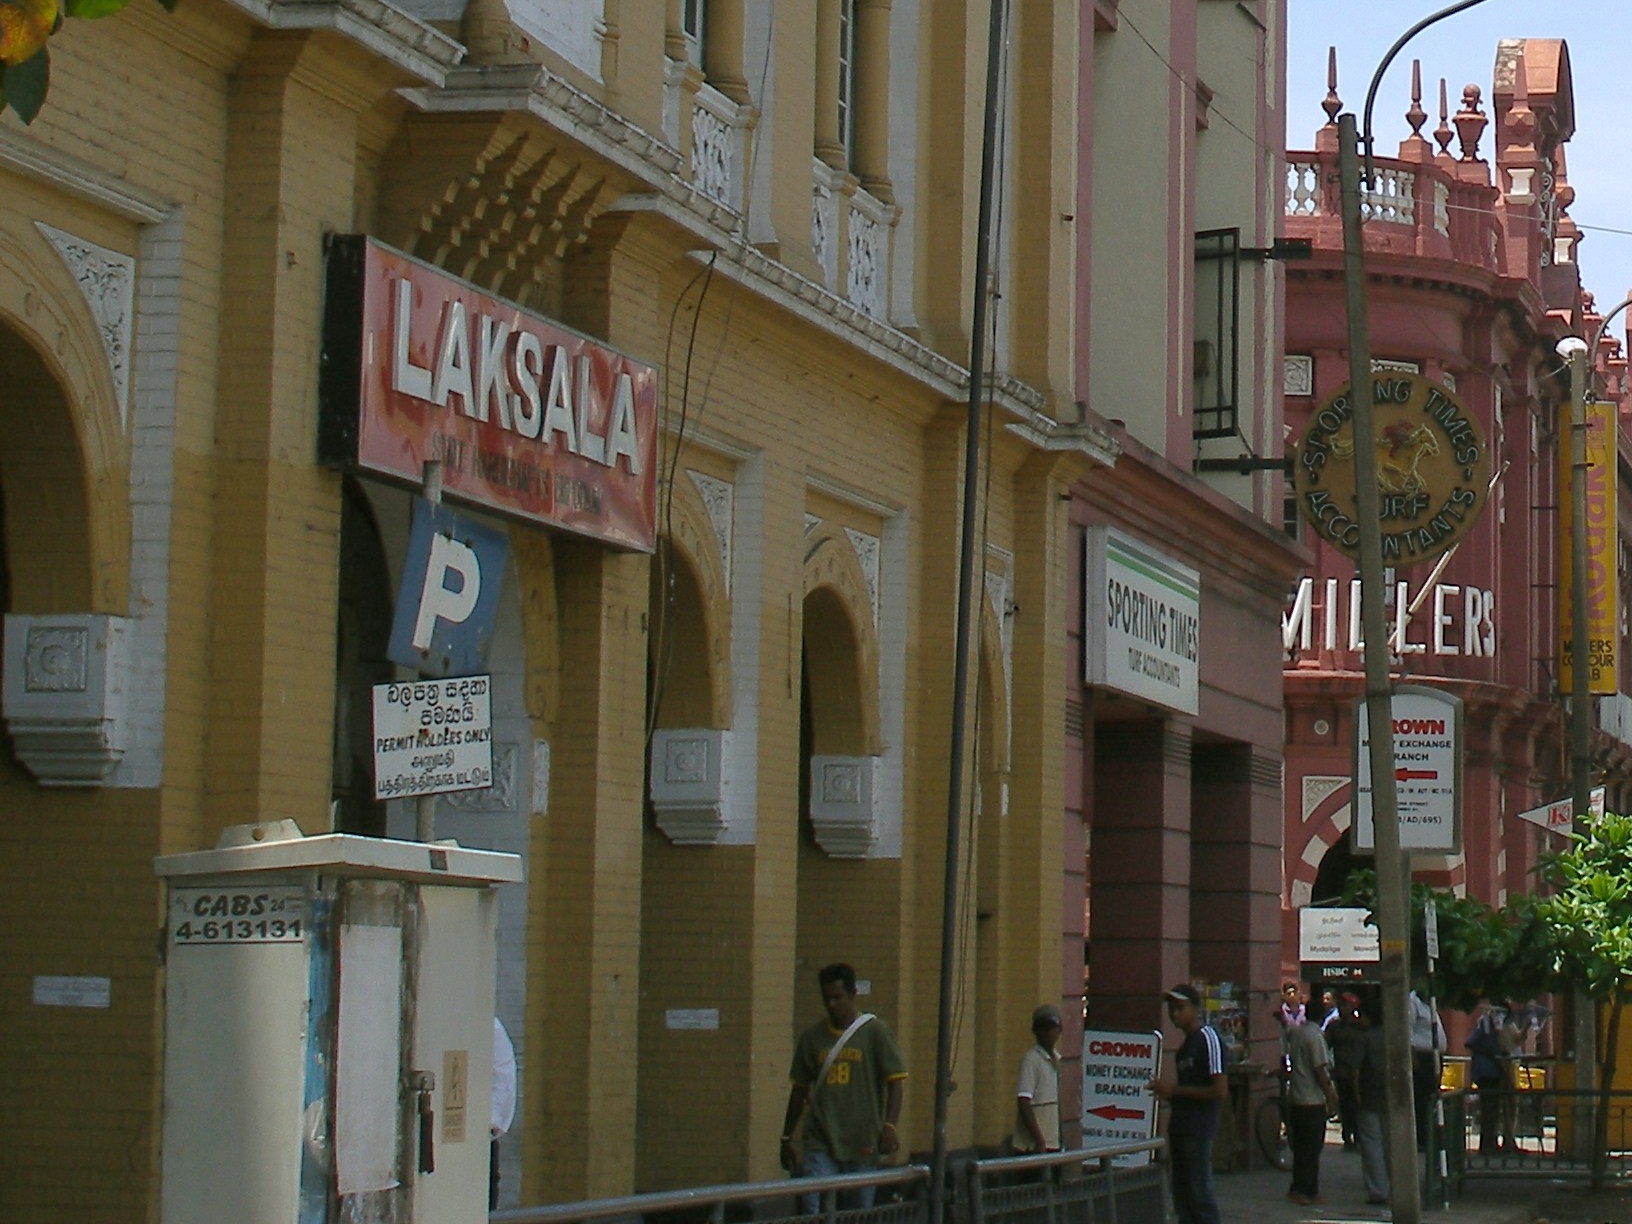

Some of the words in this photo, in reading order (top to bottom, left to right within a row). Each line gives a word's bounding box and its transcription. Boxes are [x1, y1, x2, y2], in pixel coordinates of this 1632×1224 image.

[392, 277, 640, 476] LAKSALA
[1303, 379, 1413, 467] SPORNG
[1423, 386, 1480, 466] TIMES
[1305, 487, 1477, 557] ACCONTANTS
[412, 532, 481, 651] P
[1107, 578, 1167, 649] SPORTING
[1169, 607, 1198, 663] TIMES
[1563, 640, 1613, 654] MERS
[1391, 719, 1445, 735] ROWN
[376, 735, 415, 753] PERMIT
[416, 730, 462, 749] HOLDERS
[1399, 740, 1452, 749] EXCHANGE
[1394, 753, 1429, 761] RANCH
[194, 894, 269, 917] CABS
[176, 919, 302, 940] 4-613131
[1089, 1040, 1152, 1059] CROWN
[1086, 1064, 1112, 1077] MONEY
[1113, 1065, 1153, 1080] EXCHANGE
[1095, 1083, 1140, 1097] BRANCH
